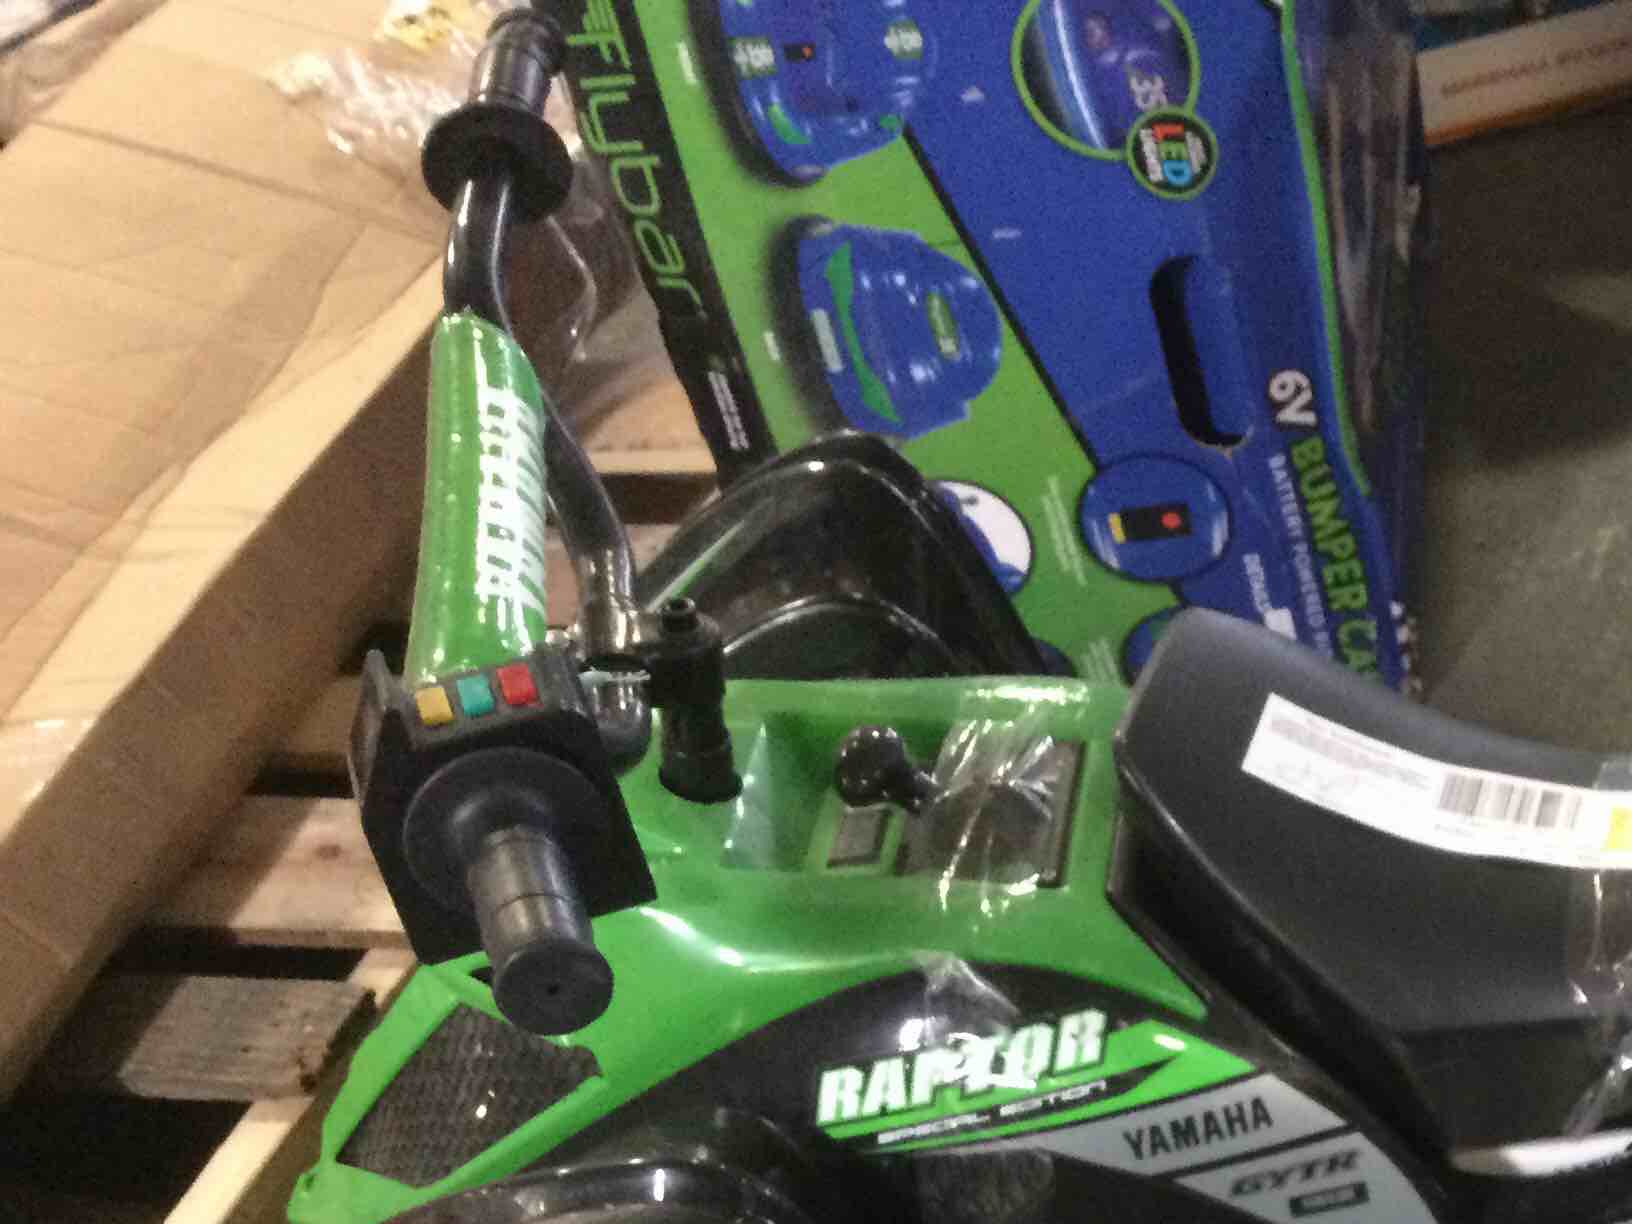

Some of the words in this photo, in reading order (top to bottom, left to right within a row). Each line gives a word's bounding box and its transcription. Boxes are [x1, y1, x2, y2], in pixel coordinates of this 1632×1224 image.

[1151, 122, 1193, 186] LED
[1268, 368, 1319, 428] 6V
[1290, 436, 1369, 613] BUMPER
[1336, 616, 1386, 676] CA
[815, 1008, 1108, 1128] RAPTOR
[1122, 1096, 1275, 1160] YAMAHA
[1229, 1148, 1361, 1198] GYTR
